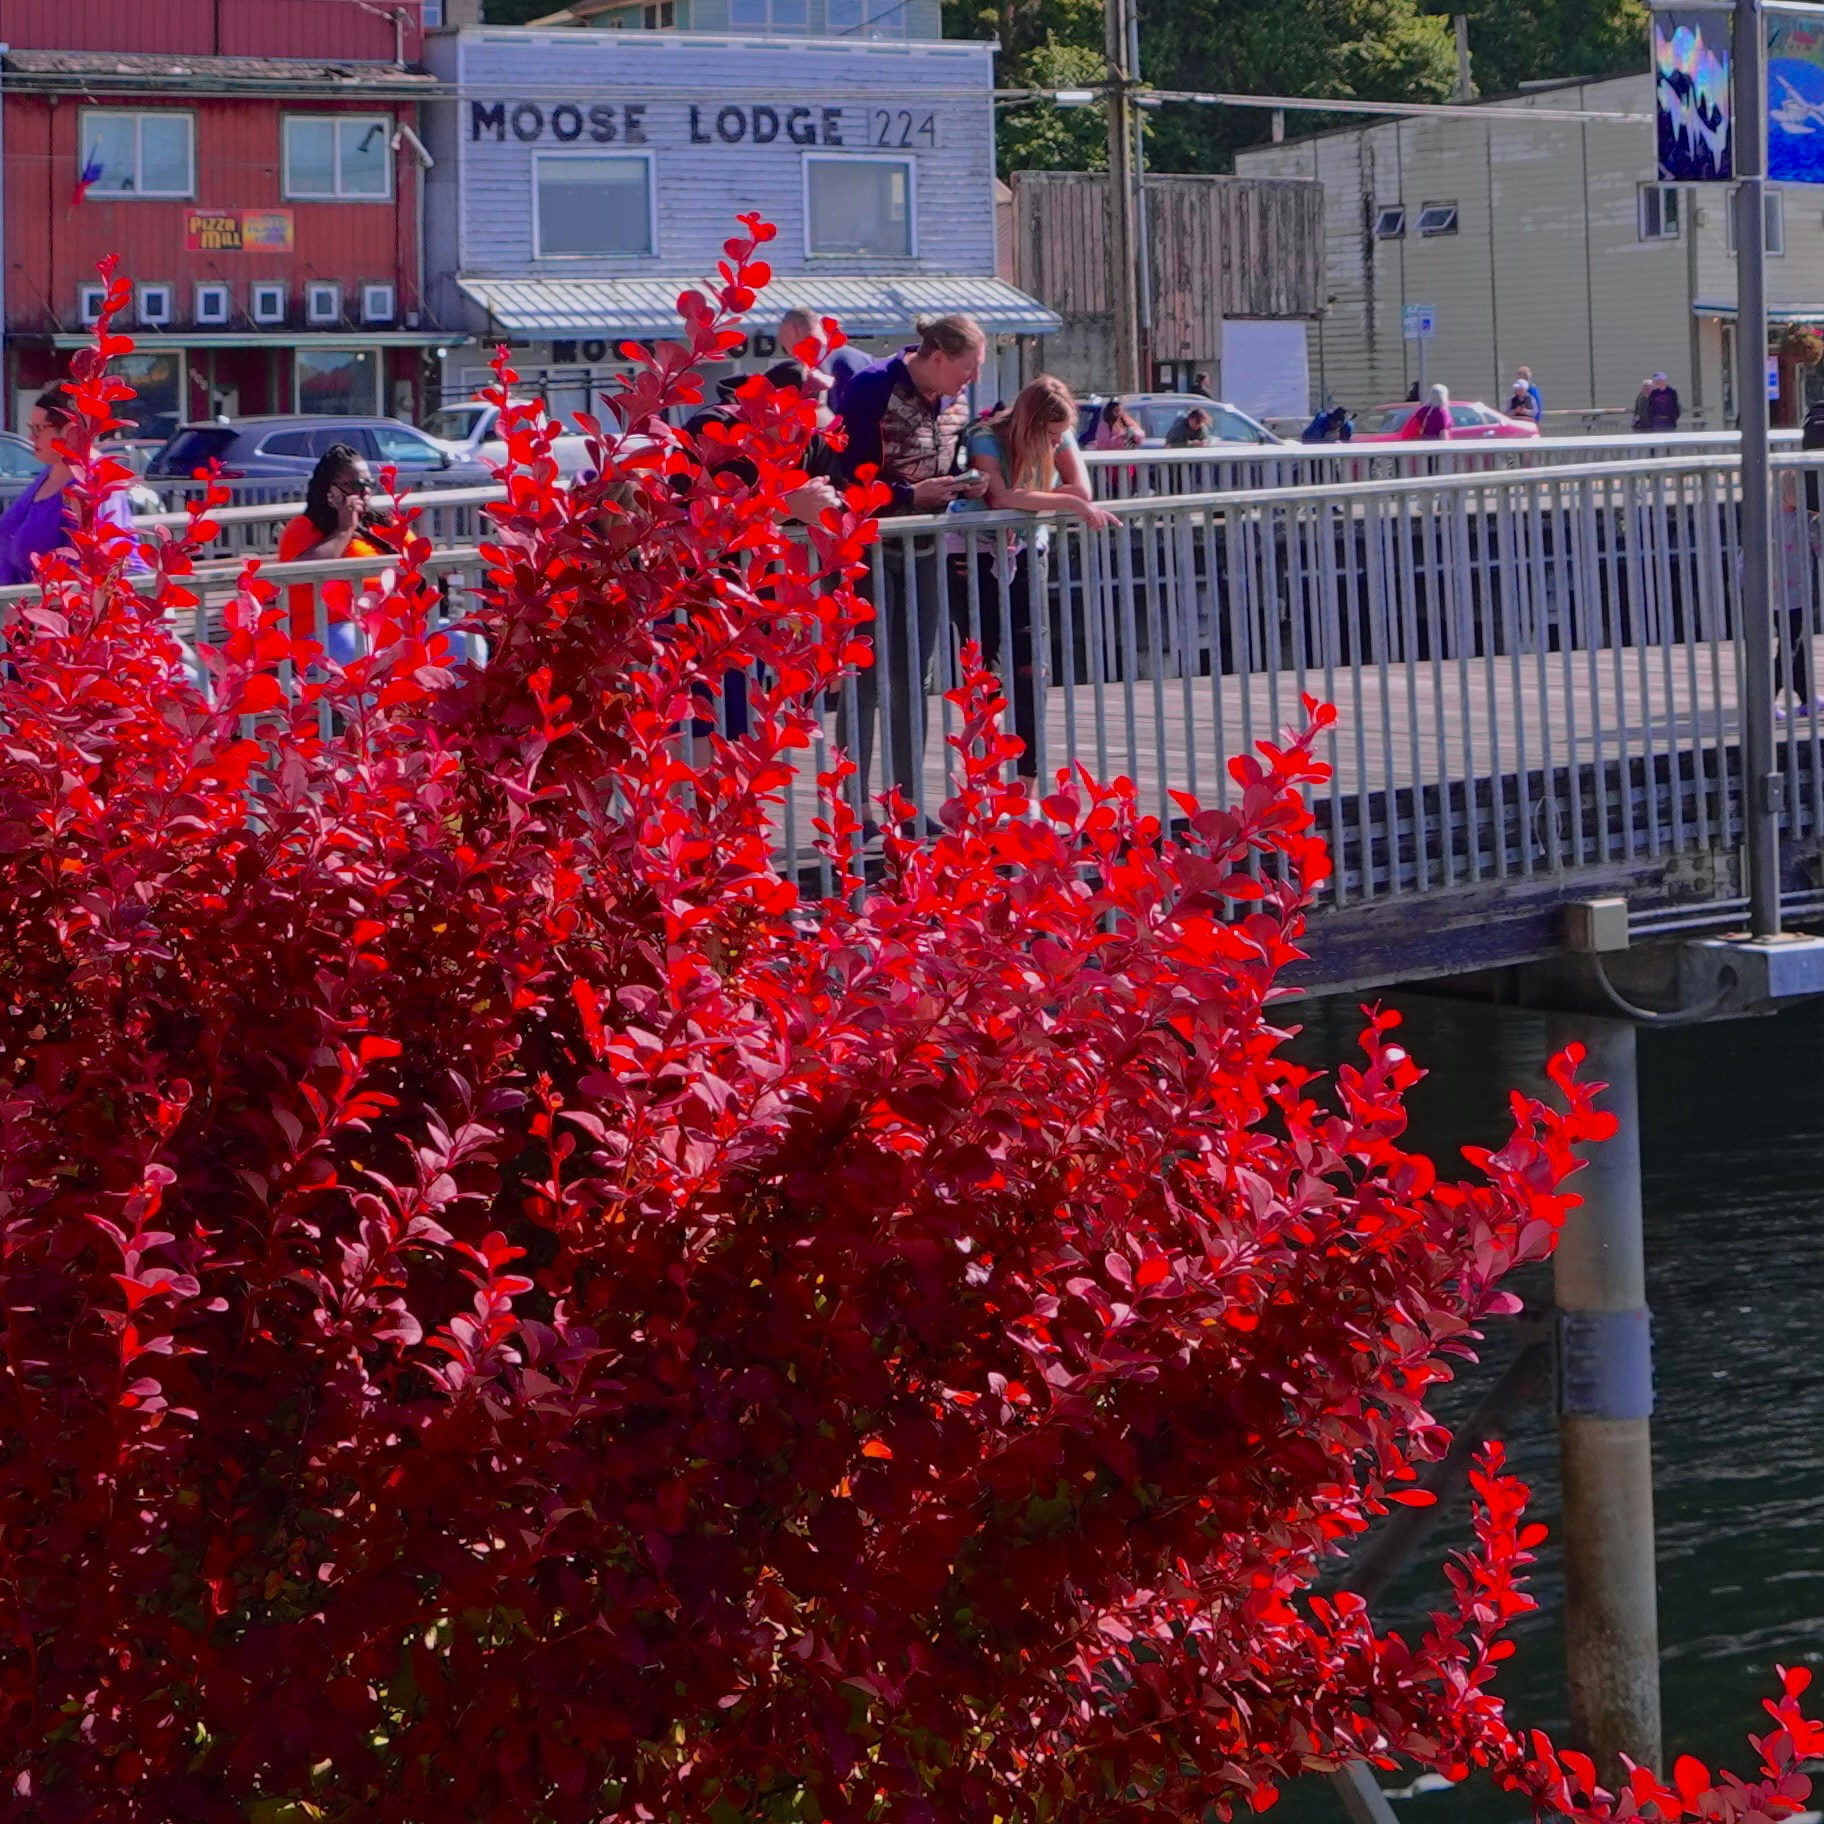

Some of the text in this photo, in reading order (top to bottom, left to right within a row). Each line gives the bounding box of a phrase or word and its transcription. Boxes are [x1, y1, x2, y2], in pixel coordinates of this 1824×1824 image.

[471, 100, 936, 148] MOOSE LODGE 224
